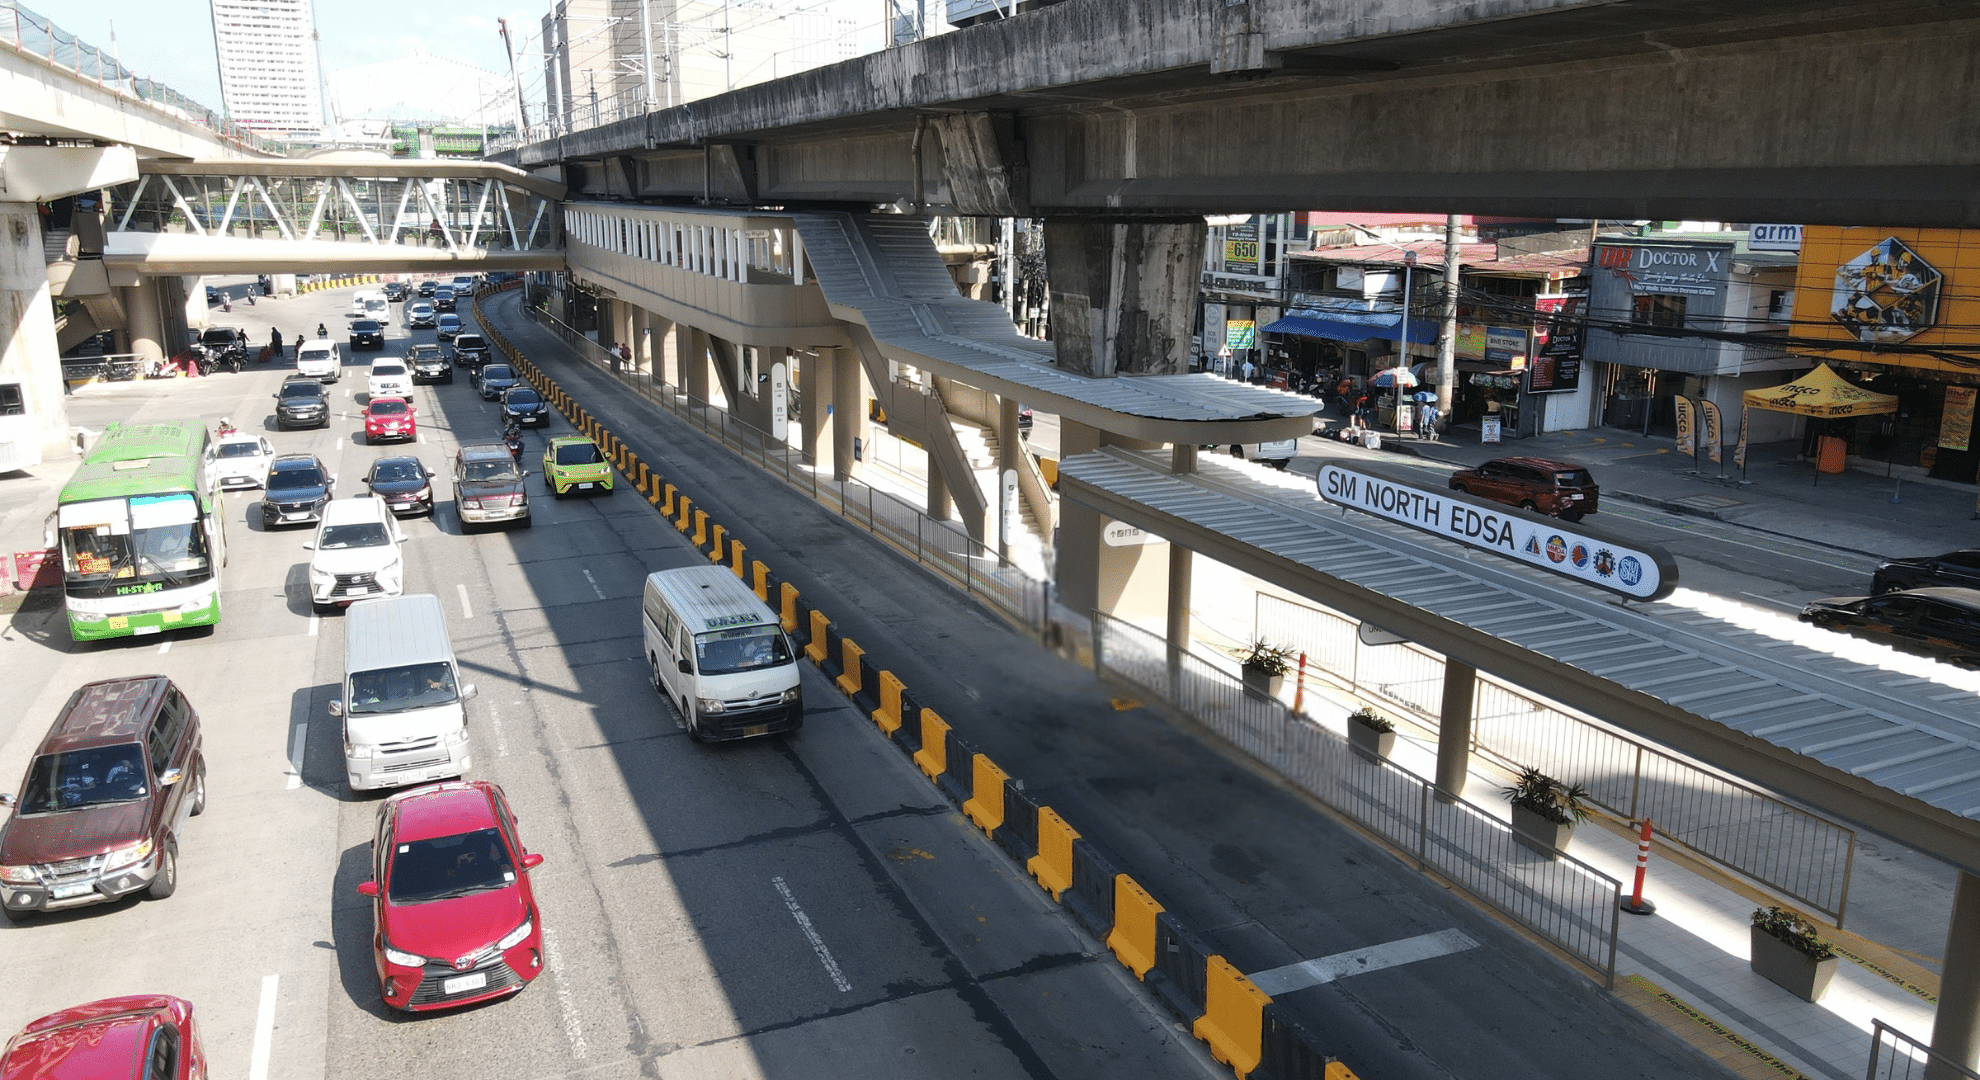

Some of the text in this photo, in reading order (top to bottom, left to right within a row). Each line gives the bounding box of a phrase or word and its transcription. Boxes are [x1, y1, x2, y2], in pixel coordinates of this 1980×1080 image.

[1754, 226, 1803, 240] arm
[1234, 243, 1257, 257] 650
[1705, 251, 1720, 272] X
[1327, 470, 1516, 550] SM NORTH EDSA
[1835, 947, 1866, 964] Lane
[1866, 963, 1905, 986] Yellow
[1658, 993, 1794, 1076] Please stay behind the
